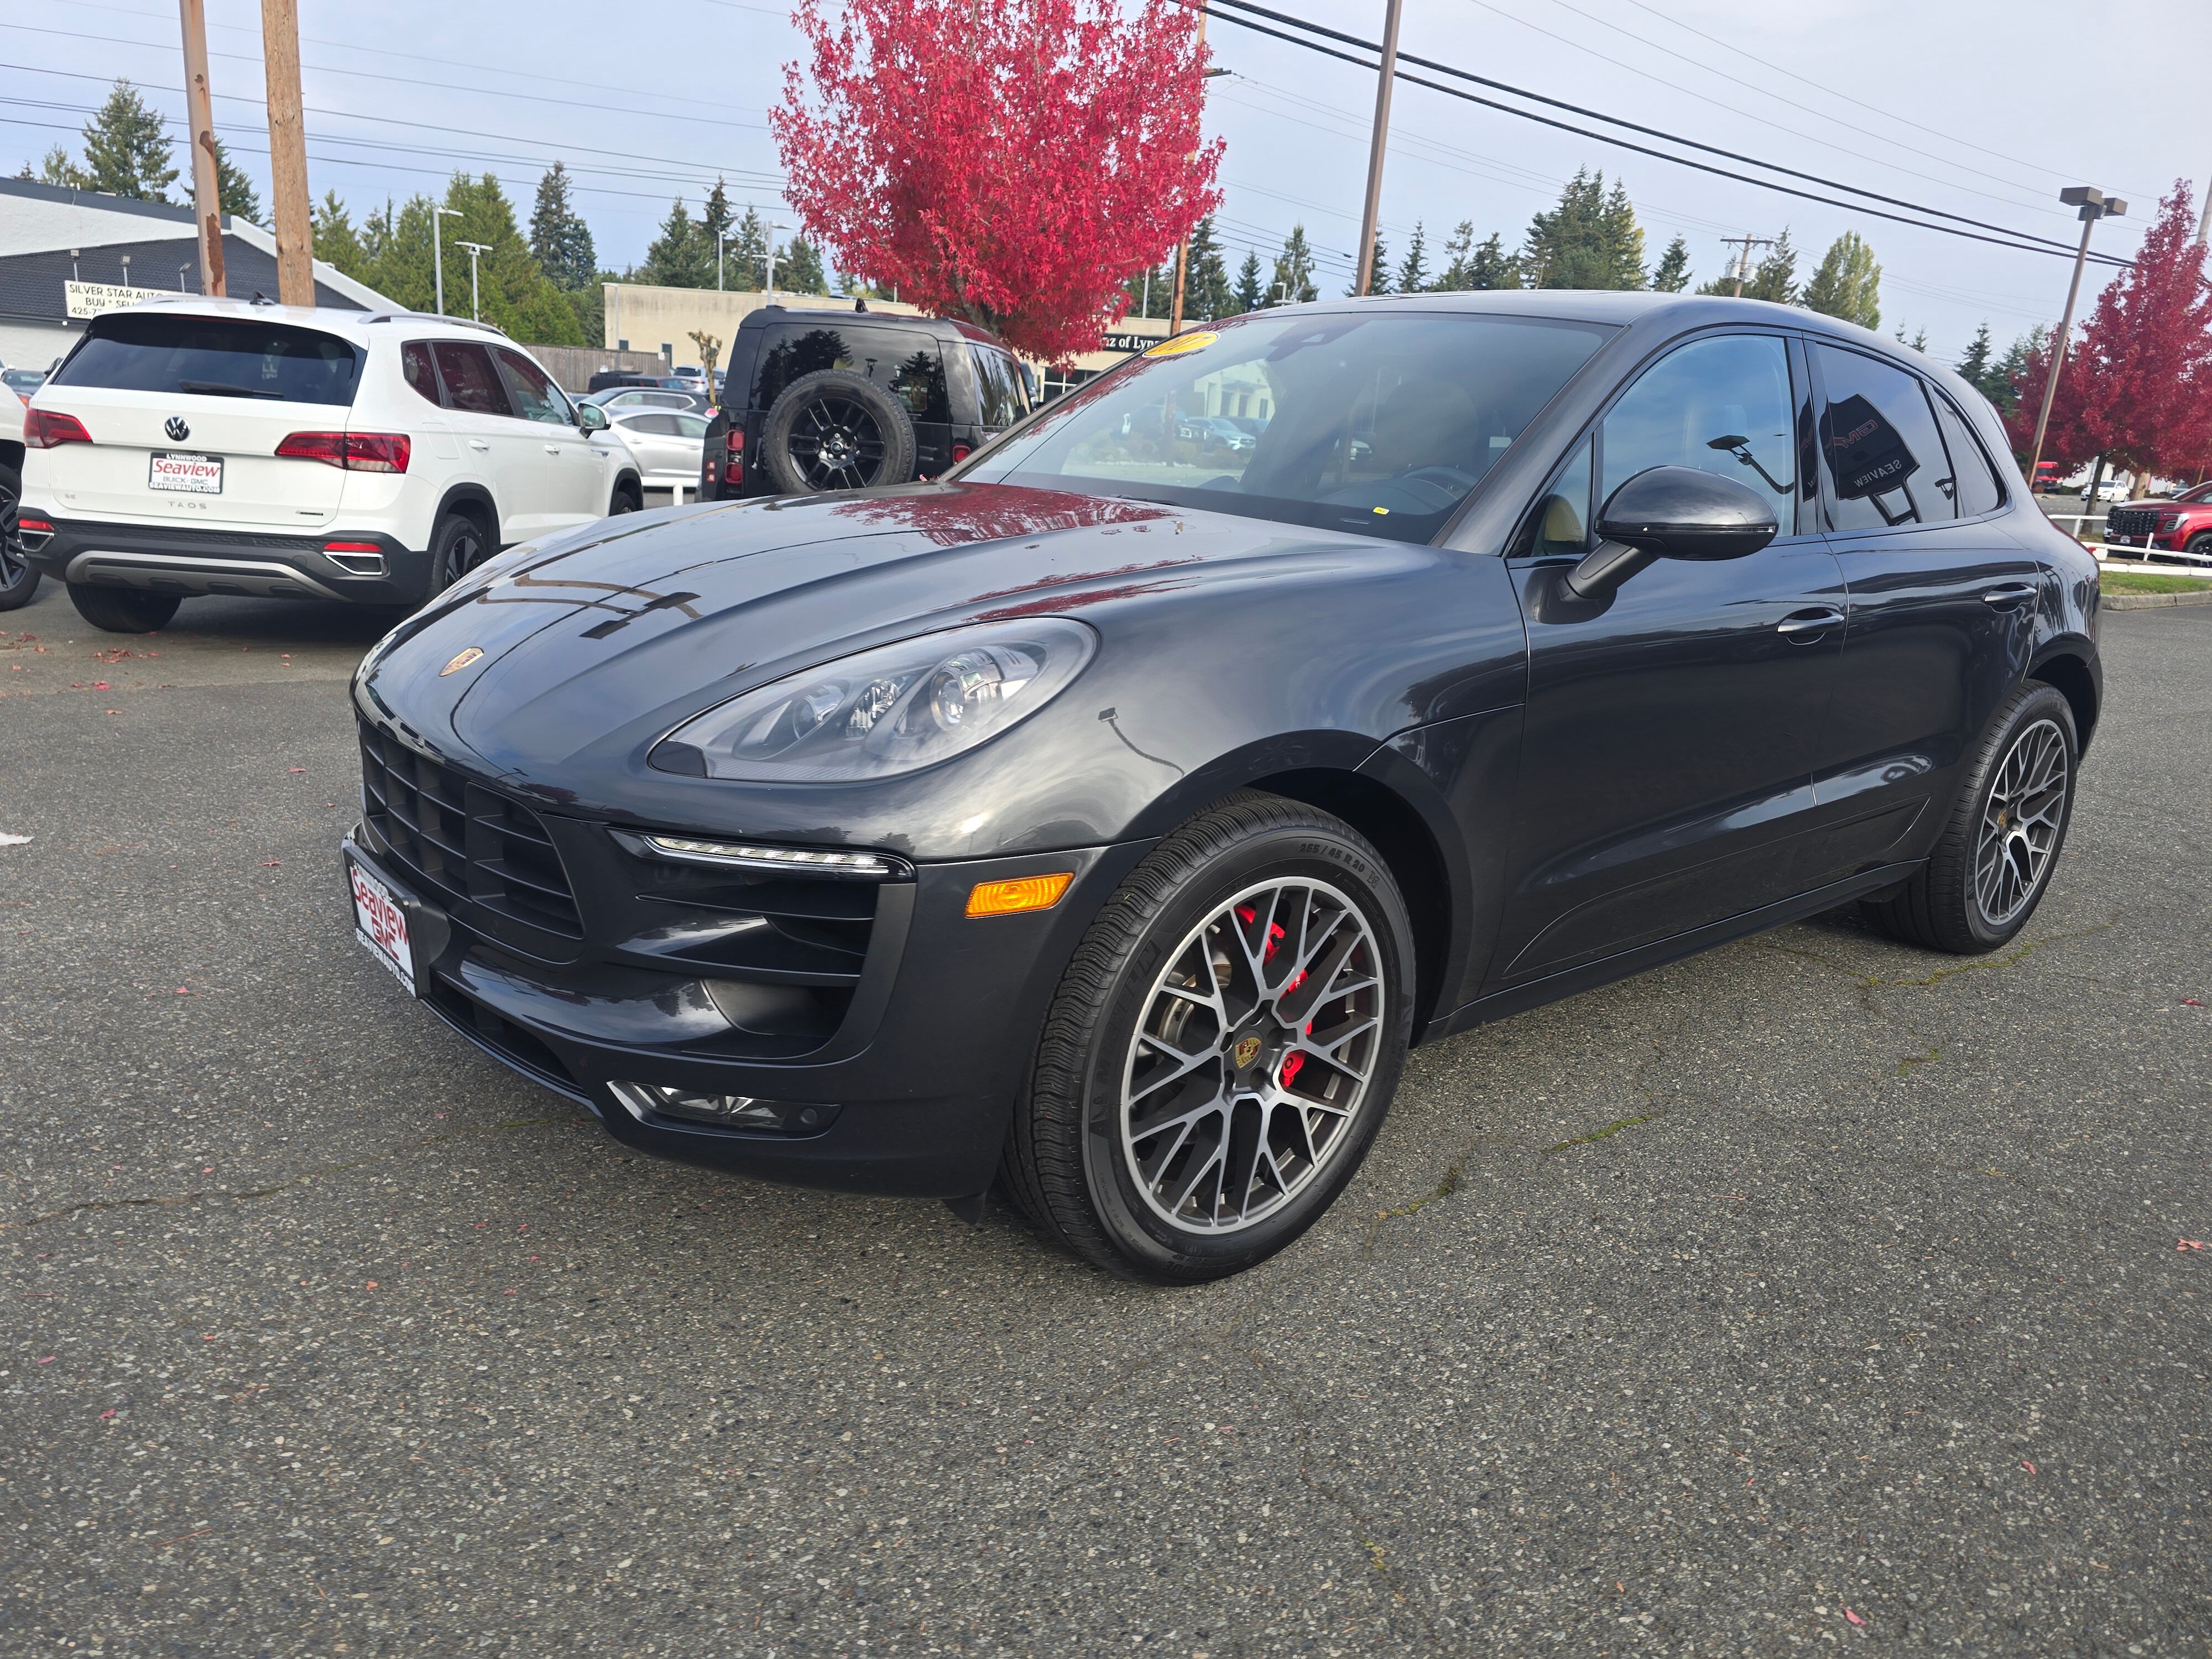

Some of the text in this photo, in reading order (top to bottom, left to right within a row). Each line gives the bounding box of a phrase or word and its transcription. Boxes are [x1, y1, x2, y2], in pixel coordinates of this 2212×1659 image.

[69, 284, 103, 295] SILVER
[107, 289, 133, 299] STAR
[86, 298, 106, 307] BUY
[71, 307, 102, 316] 425-7
[1118, 336, 1132, 348] of
[166, 453, 208, 462] LYNNWOOD
[153, 460, 221, 477] Seaview
[163, 476, 186, 484] BUICK
[149, 481, 221, 493] SEAVIEWAUTO.COM
[168, 501, 207, 509] TAOS
[1343, 853, 1353, 864] R
[1352, 859, 1365, 873] 20
[353, 868, 408, 945] Seaview
[371, 916, 399, 961] GMC
